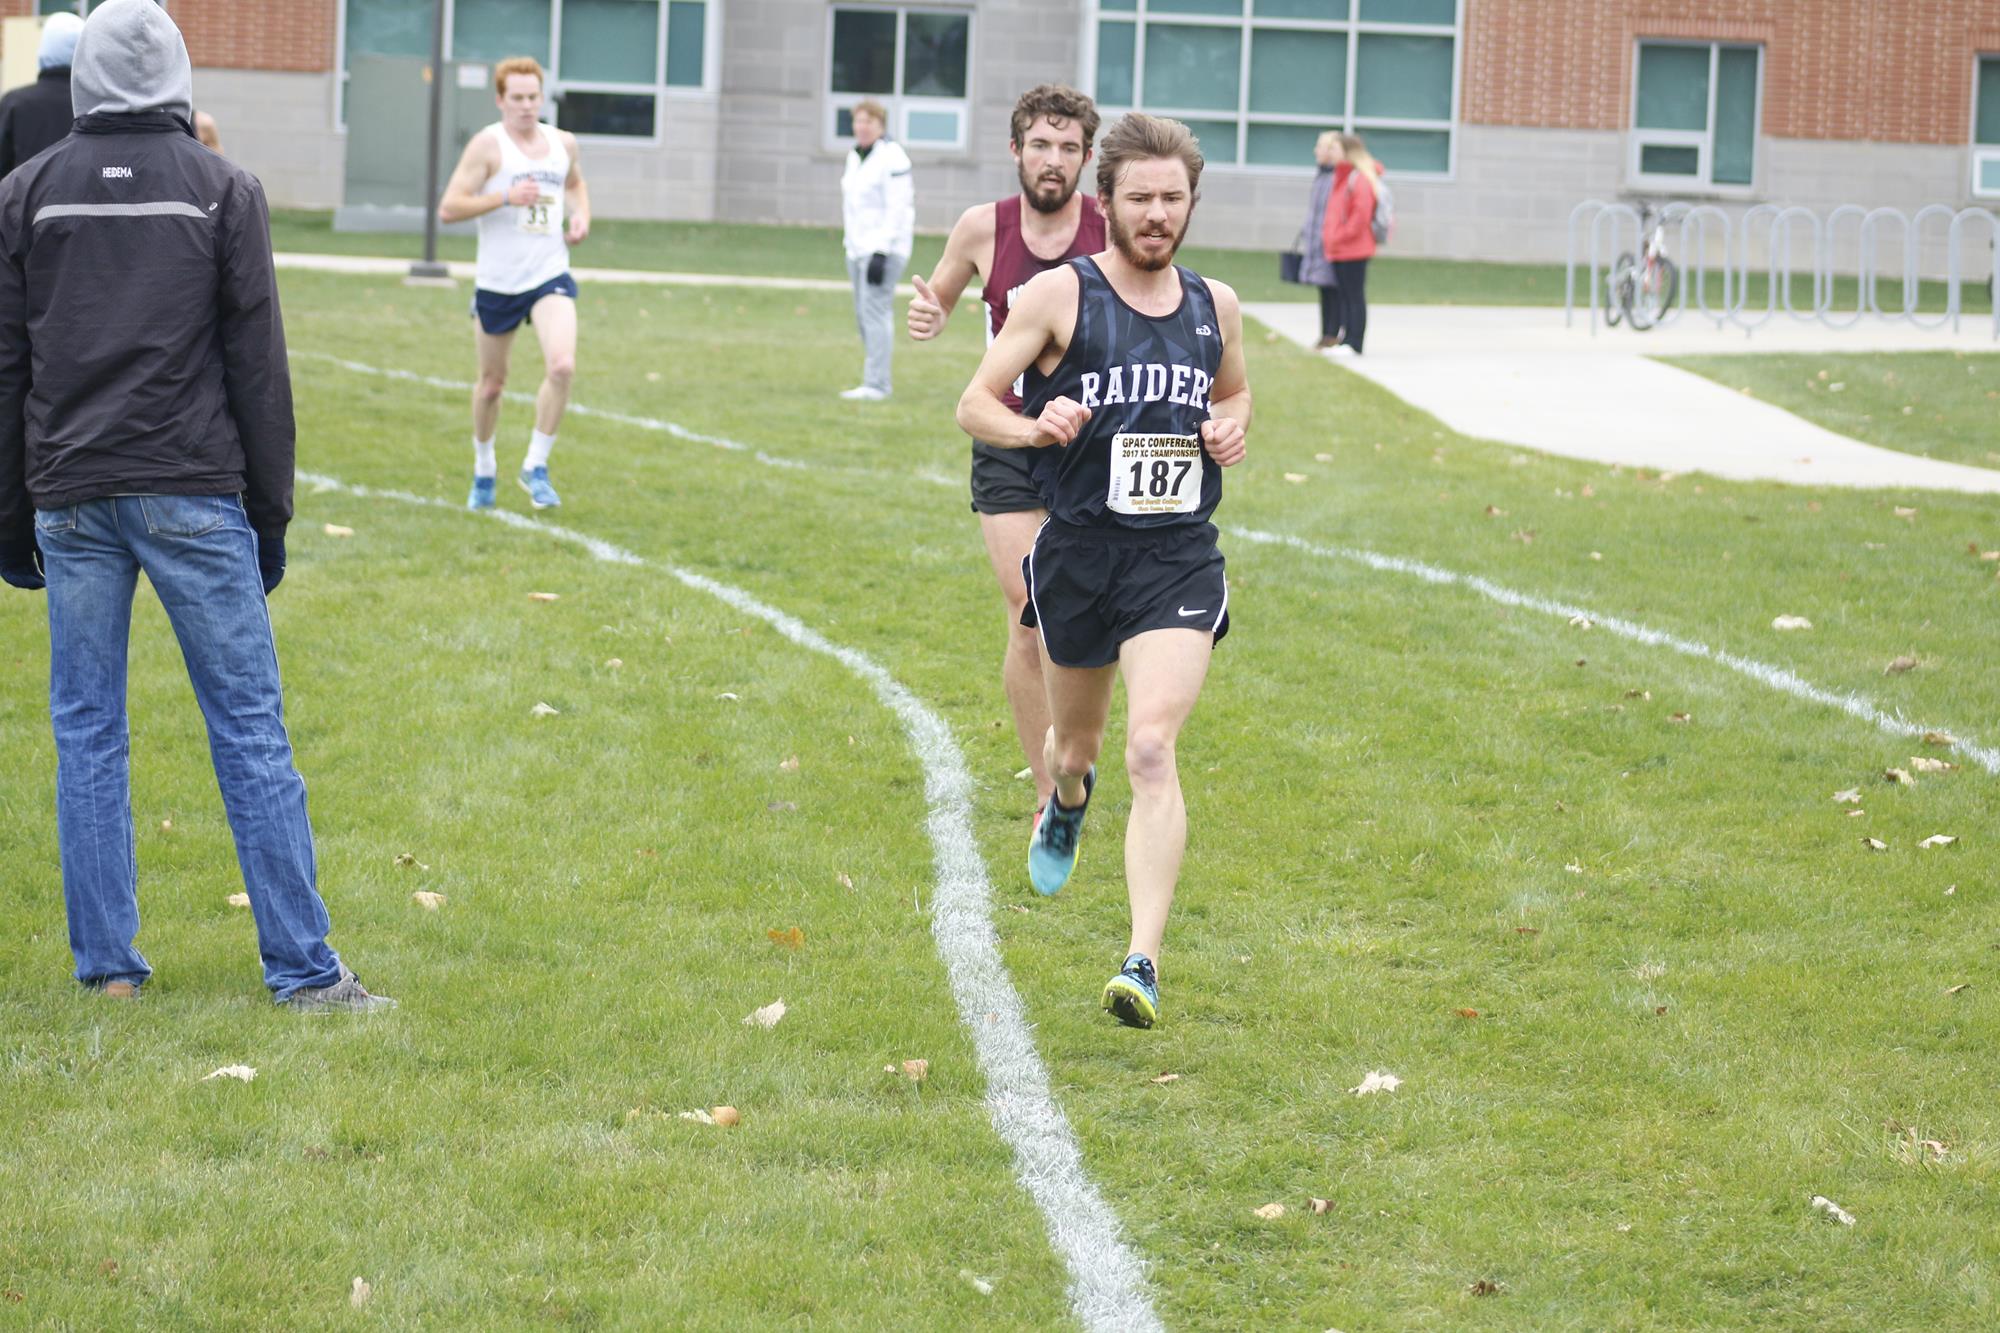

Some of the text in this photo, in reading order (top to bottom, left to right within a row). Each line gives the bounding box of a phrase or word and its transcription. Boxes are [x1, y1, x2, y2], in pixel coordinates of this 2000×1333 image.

[1122, 438, 1146, 448] GPAC
[1122, 449, 1139, 458] 2017
[1140, 449, 1149, 458] XC
[1128, 460, 1192, 497] 187
